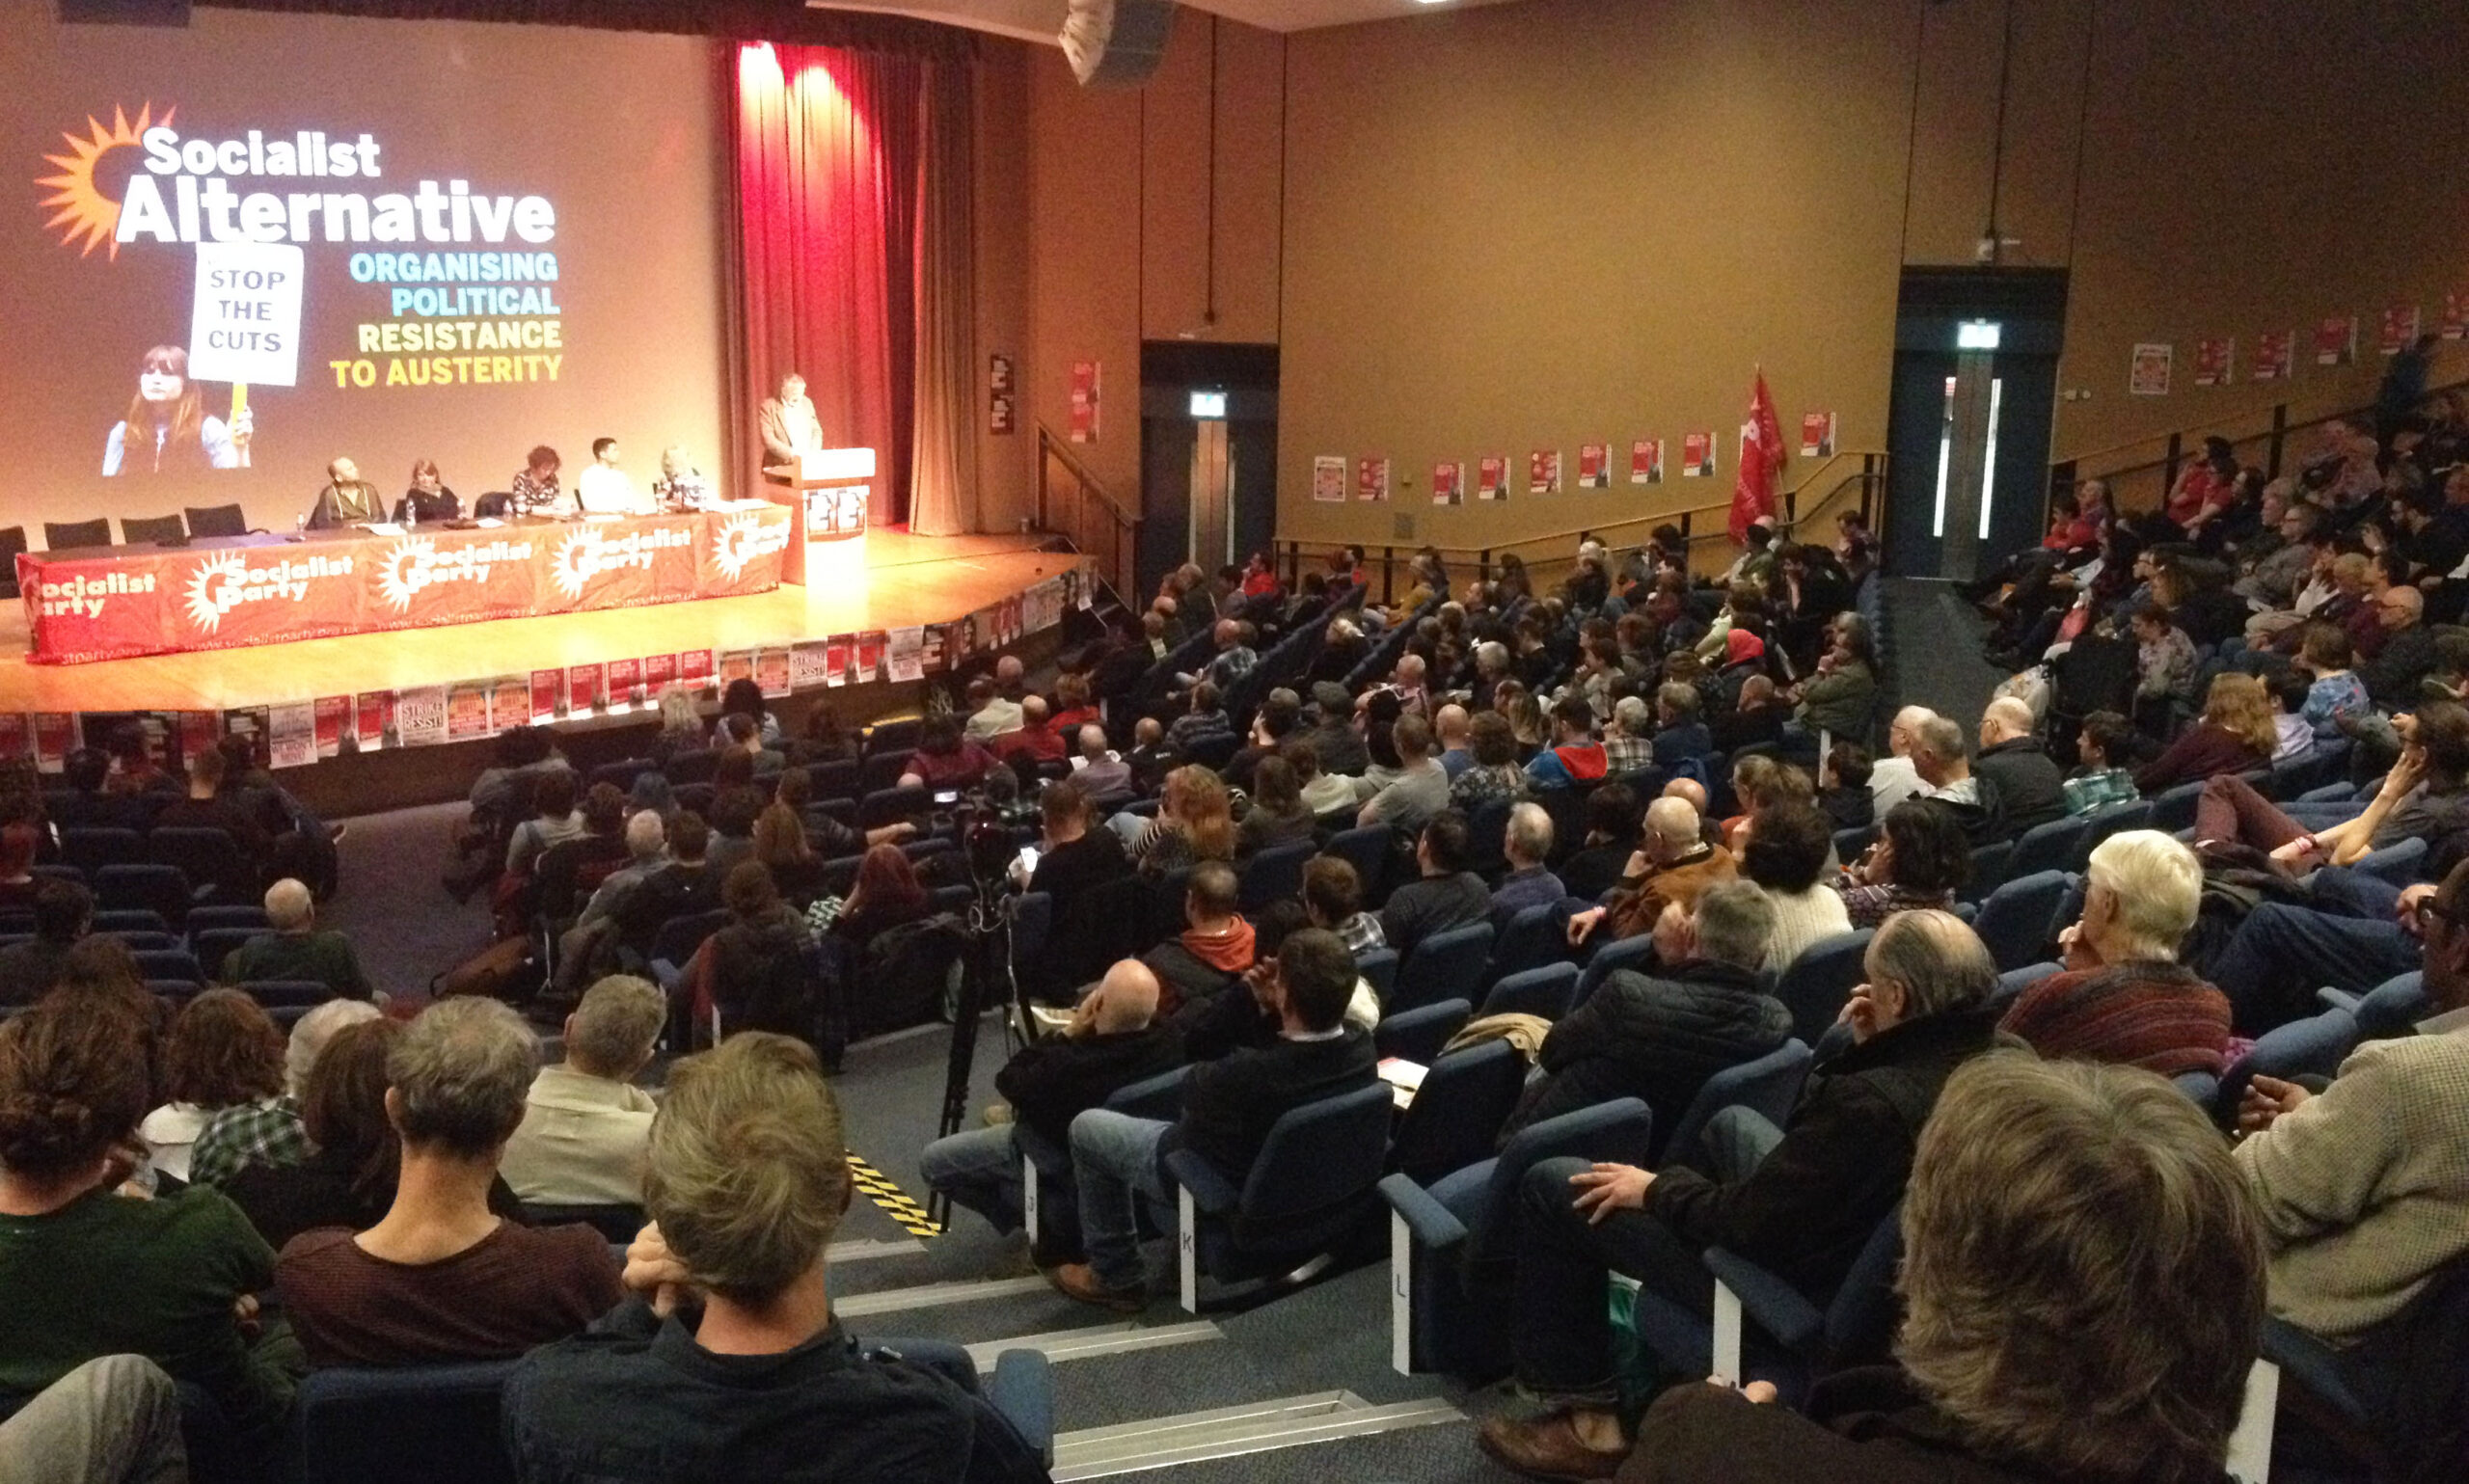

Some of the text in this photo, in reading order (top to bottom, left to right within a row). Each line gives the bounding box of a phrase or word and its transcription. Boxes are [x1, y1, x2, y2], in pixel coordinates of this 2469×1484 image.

[142, 126, 382, 177] Socialist
[115, 174, 556, 244] Alternative
[210, 269, 285, 290] STOP
[349, 252, 559, 283] ORGANISING
[218, 299, 273, 321] THE
[391, 286, 561, 316] POLITICAL
[208, 330, 282, 352] CUTS
[358, 320, 563, 353] RESISTANCE
[329, 354, 563, 388] TO AUSTERITY
[415, 540, 533, 568] Socialist
[583, 528, 692, 556] Socialist
[223, 555, 354, 587] Socialist
[405, 563, 491, 594] Party
[577, 550, 654, 581] Party
[41, 573, 156, 598] ocialist
[215, 580, 309, 613] Party
[1182, 1232, 1192, 1254] K
[1397, 1274, 1407, 1298] L
